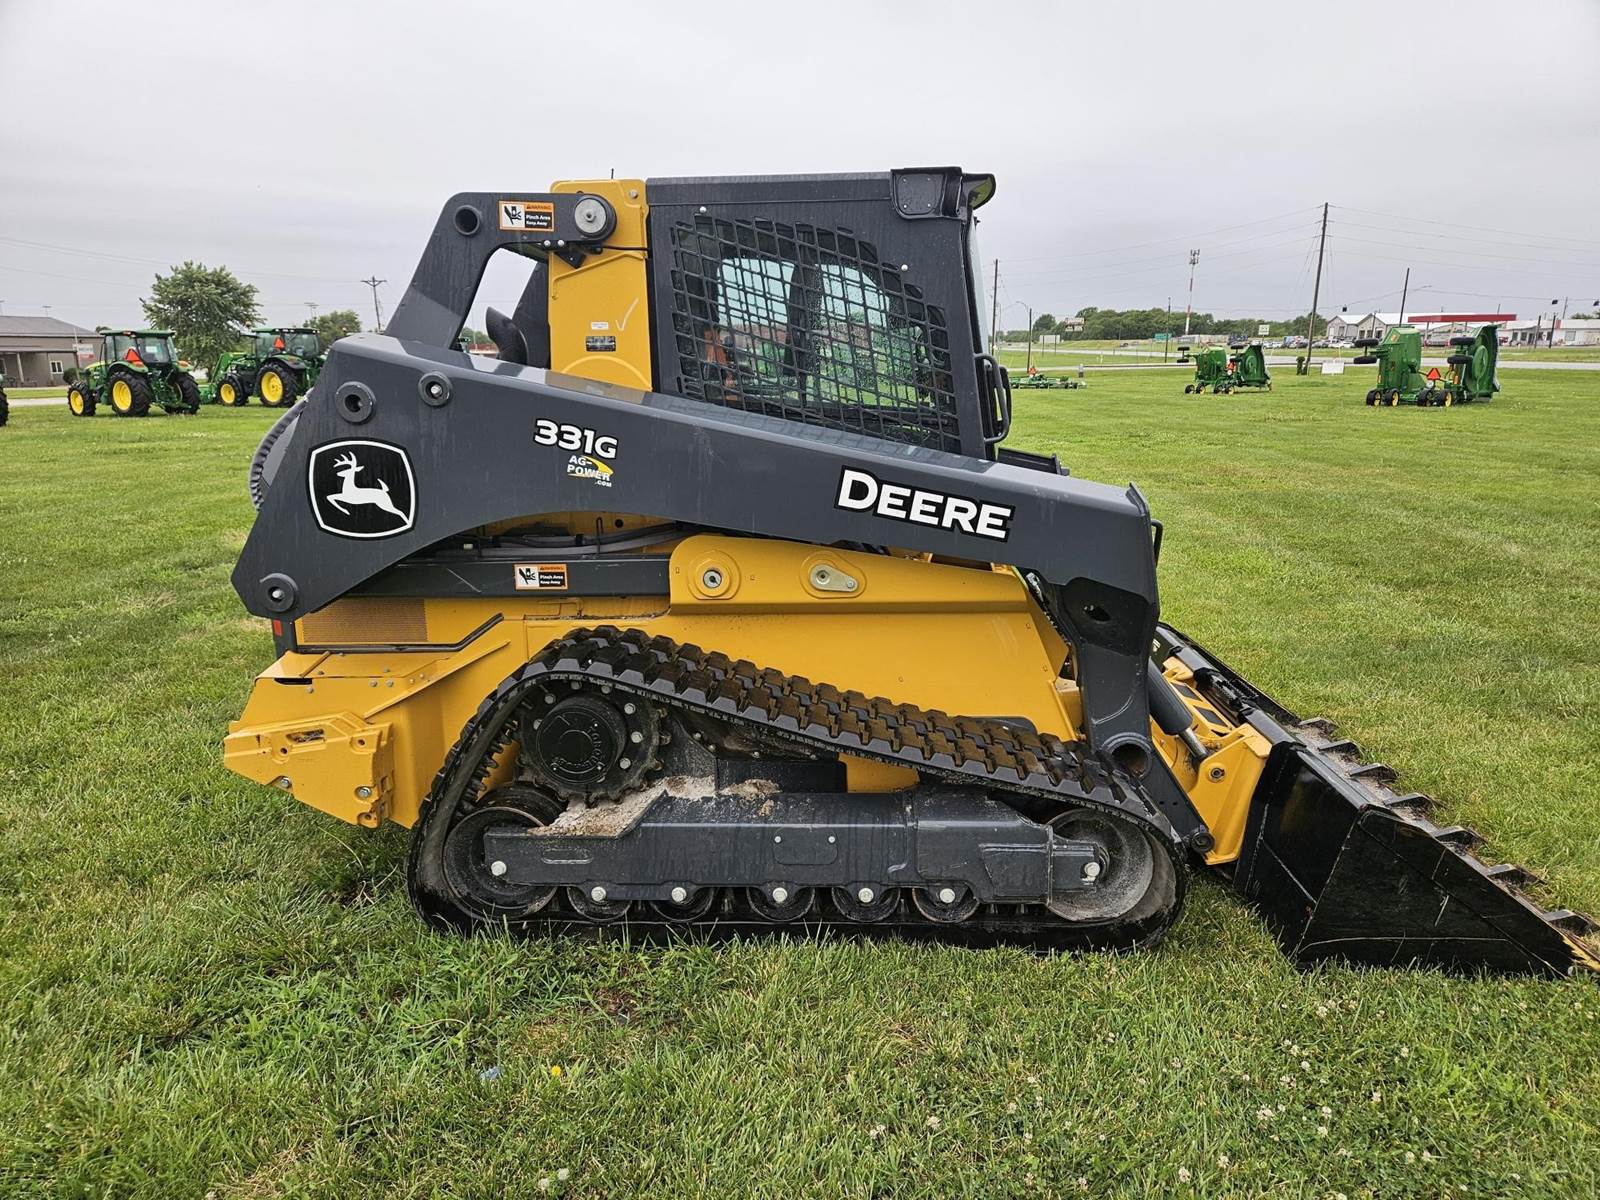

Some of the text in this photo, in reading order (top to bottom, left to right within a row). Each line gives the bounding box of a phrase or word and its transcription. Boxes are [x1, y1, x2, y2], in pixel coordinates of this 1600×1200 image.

[534, 419, 618, 459] 331G
[567, 464, 611, 482] POWER
[837, 468, 1012, 539] DEERE
